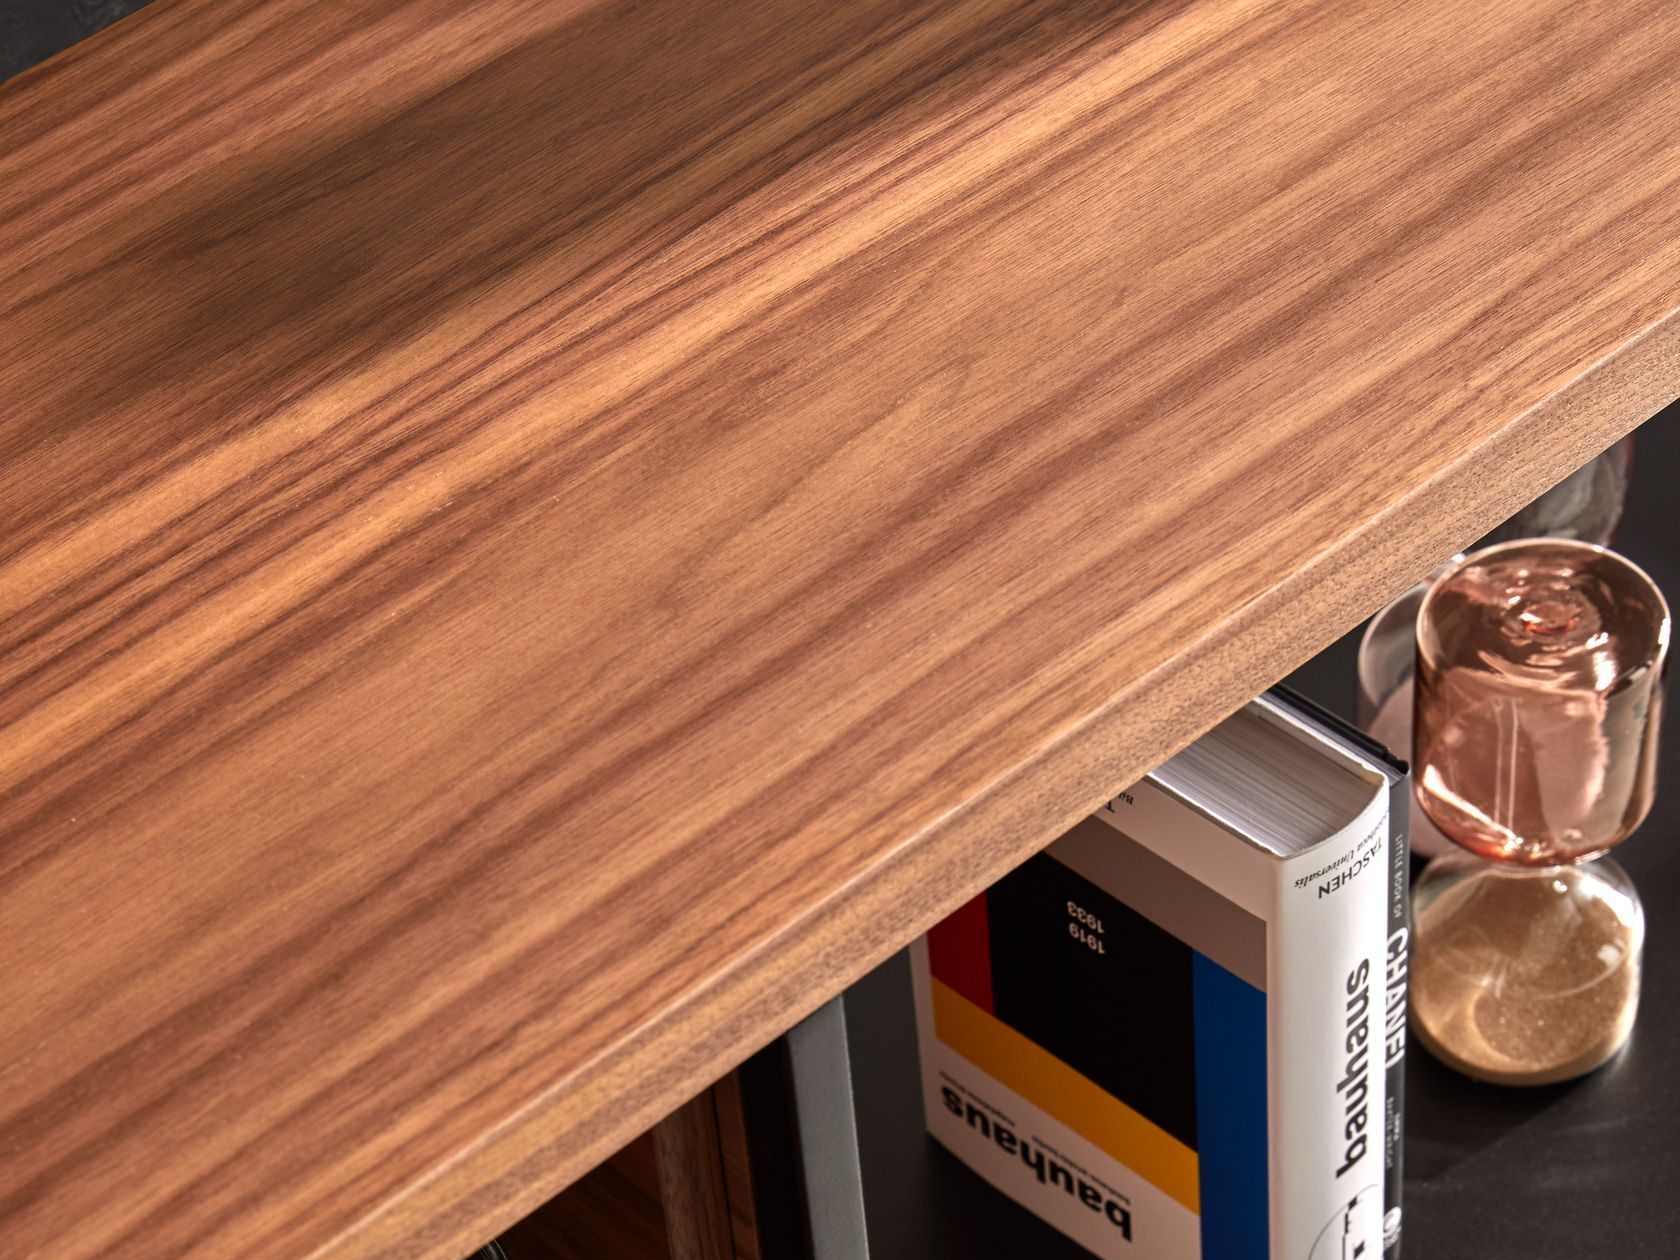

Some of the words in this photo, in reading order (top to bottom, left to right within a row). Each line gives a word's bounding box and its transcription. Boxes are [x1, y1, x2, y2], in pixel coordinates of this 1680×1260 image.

[1294, 849, 1355, 889] Universalis
[1318, 837, 1382, 899] TASCHEN
[1067, 900, 1105, 933] 1933
[1068, 923, 1106, 954] 1919
[1335, 958, 1370, 1179] bauhaus
[940, 1085, 1133, 1243] bauhaus
